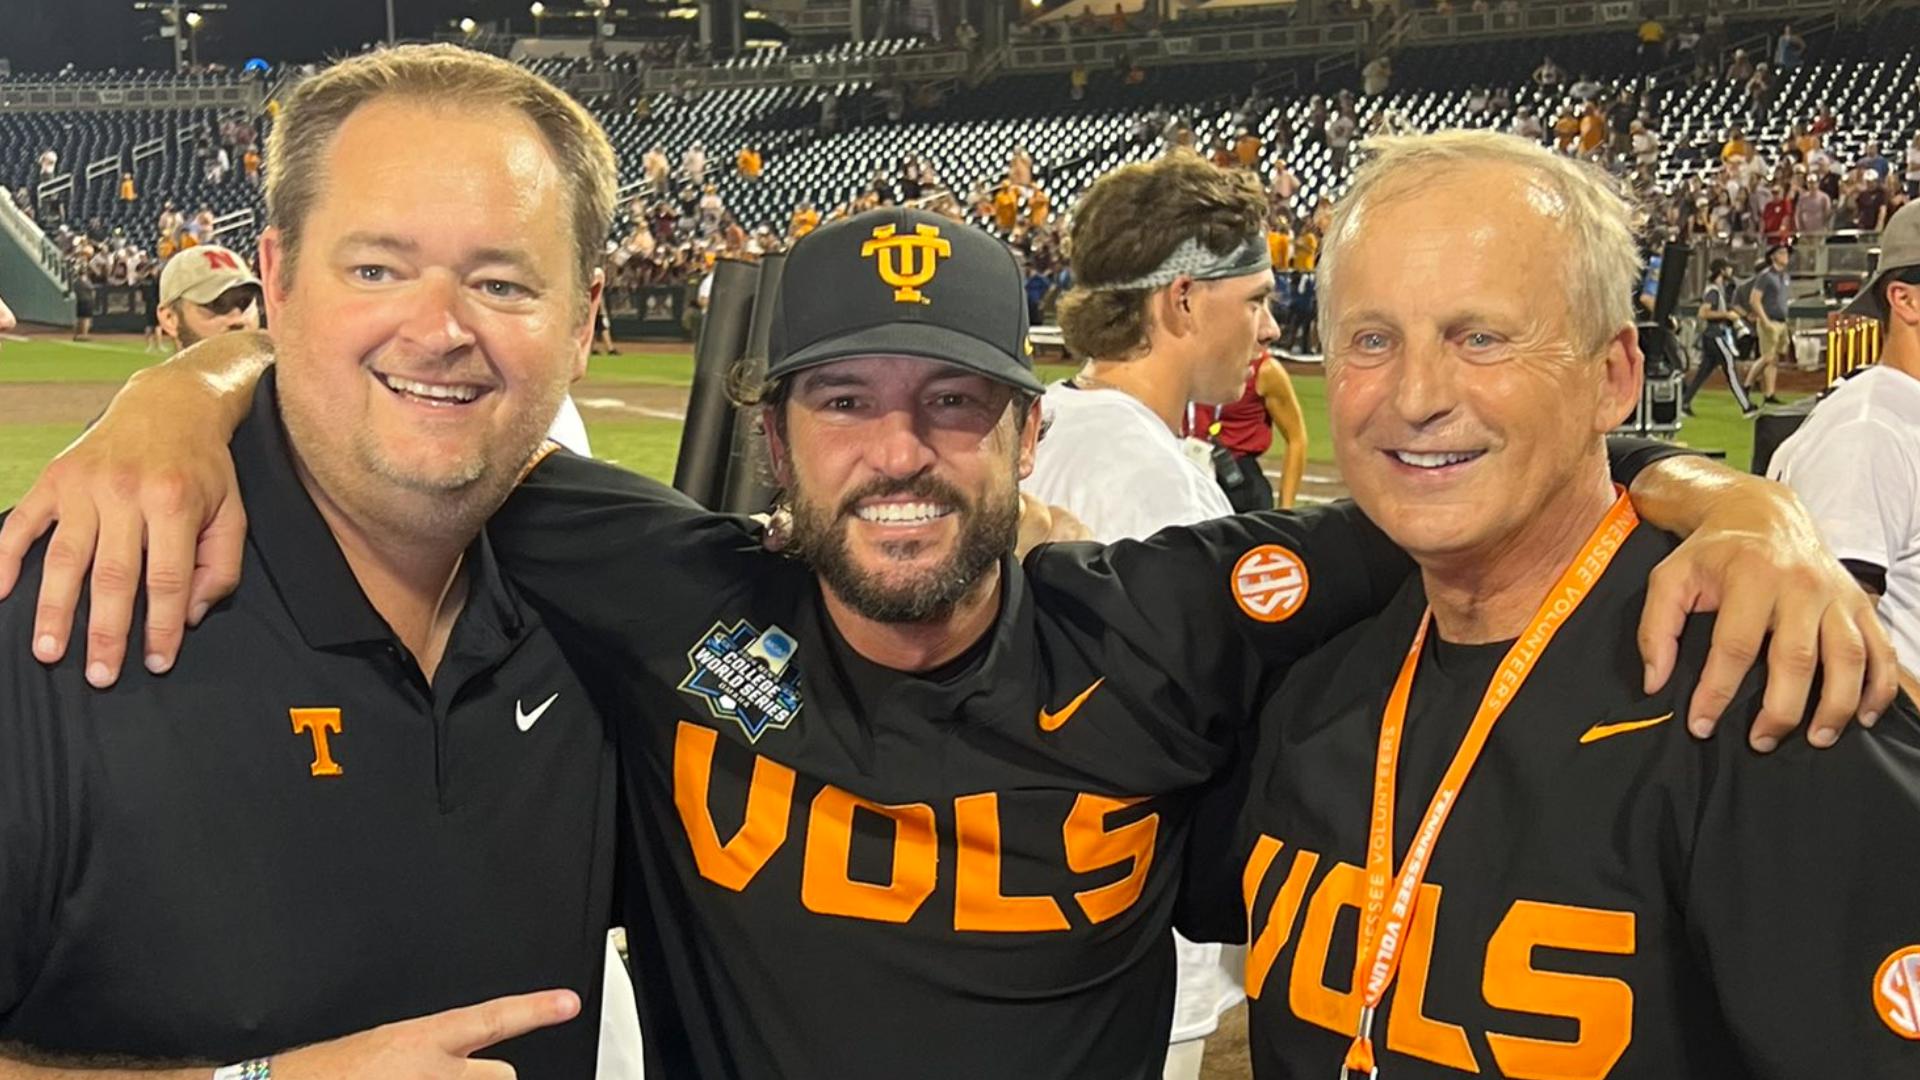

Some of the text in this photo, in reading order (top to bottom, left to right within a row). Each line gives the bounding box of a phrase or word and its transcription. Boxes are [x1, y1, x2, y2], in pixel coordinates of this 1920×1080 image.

[202, 250, 239, 269] N
[1237, 552, 1303, 615] SEC
[694, 647, 745, 689] WORLD
[740, 683, 790, 722] SERIES
[722, 650, 781, 698] COLLEGE
[1488, 585, 1581, 710] VOLUNTEERS
[289, 707, 342, 776] T
[674, 720, 1159, 932] VOLS
[1371, 725, 1397, 864] VOLUNTEERS
[1392, 788, 1454, 919] TENNESSEE
[1242, 833, 1636, 1080] VOLS
